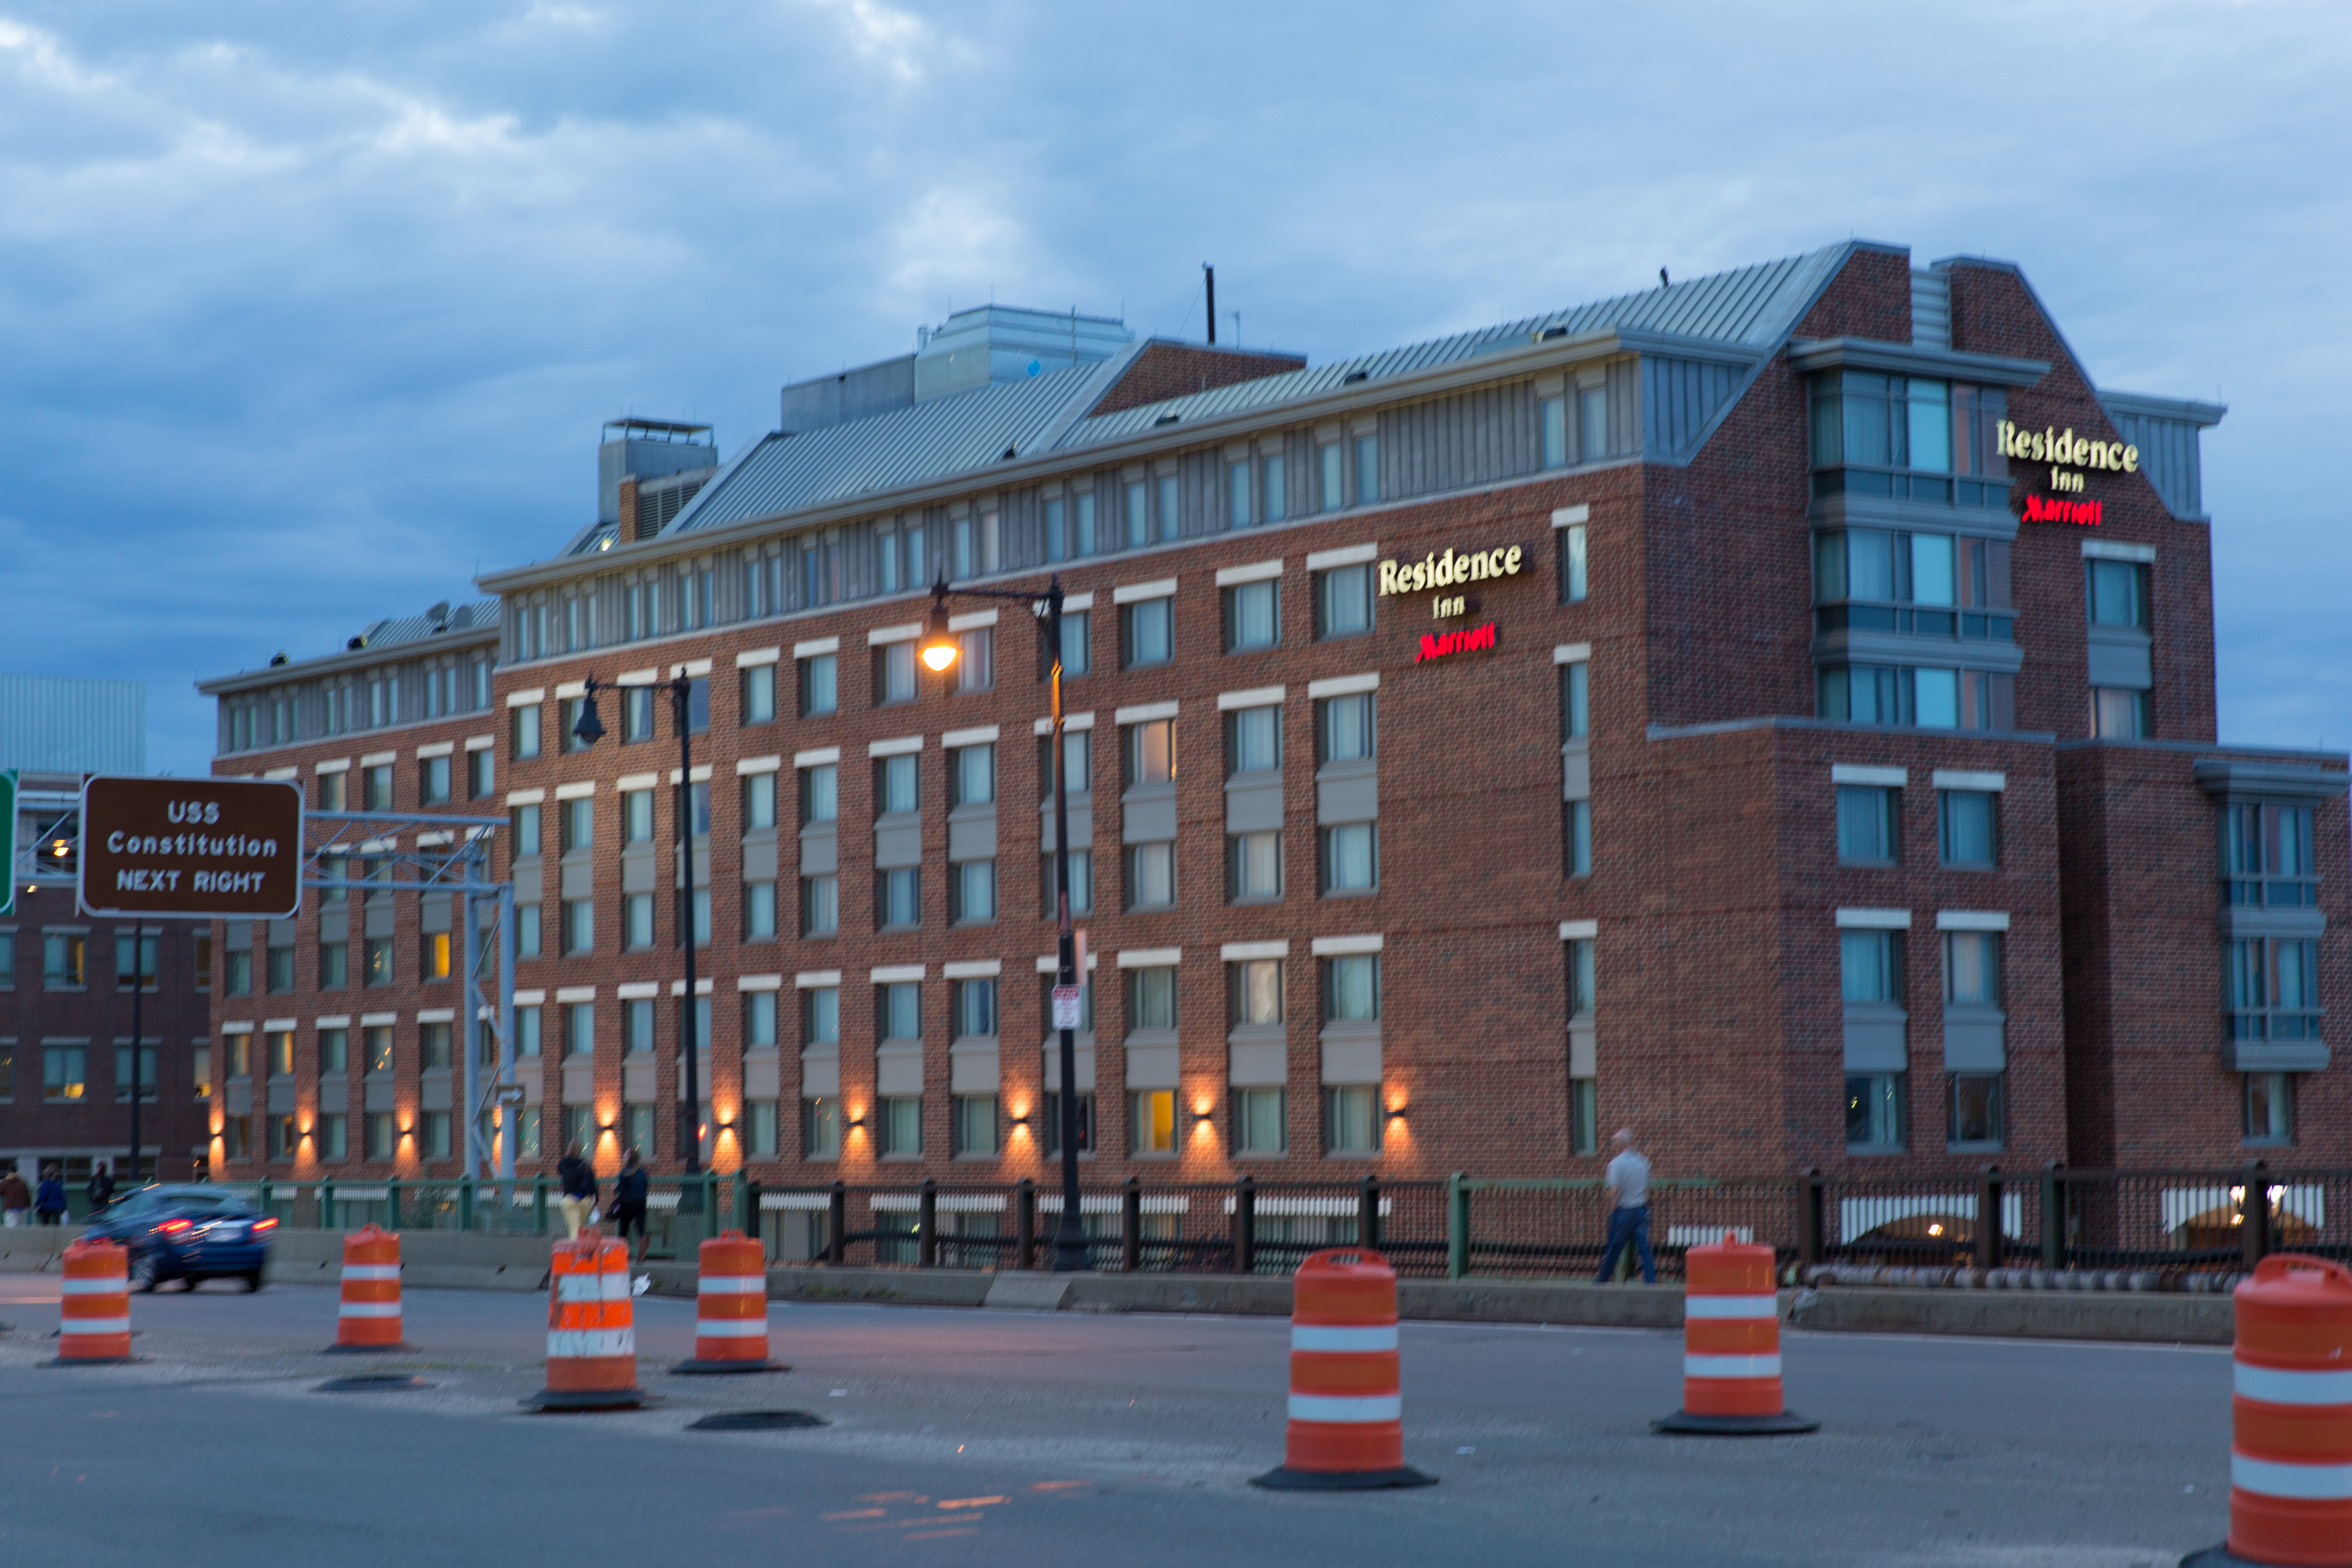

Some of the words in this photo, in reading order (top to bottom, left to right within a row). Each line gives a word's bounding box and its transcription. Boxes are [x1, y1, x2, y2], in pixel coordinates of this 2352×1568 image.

[1995, 419, 2139, 473] Residence
[2050, 465, 2085, 492] Inn
[2021, 493, 2102, 526] Marriott
[1378, 544, 1522, 596] Residence
[1432, 595, 1466, 619] Inn
[1414, 621, 1496, 663] Marriott
[167, 800, 220, 825] USS
[107, 830, 278, 858] Constitution
[116, 869, 181, 892] NEXT
[193, 870, 266, 894] RIGHT
